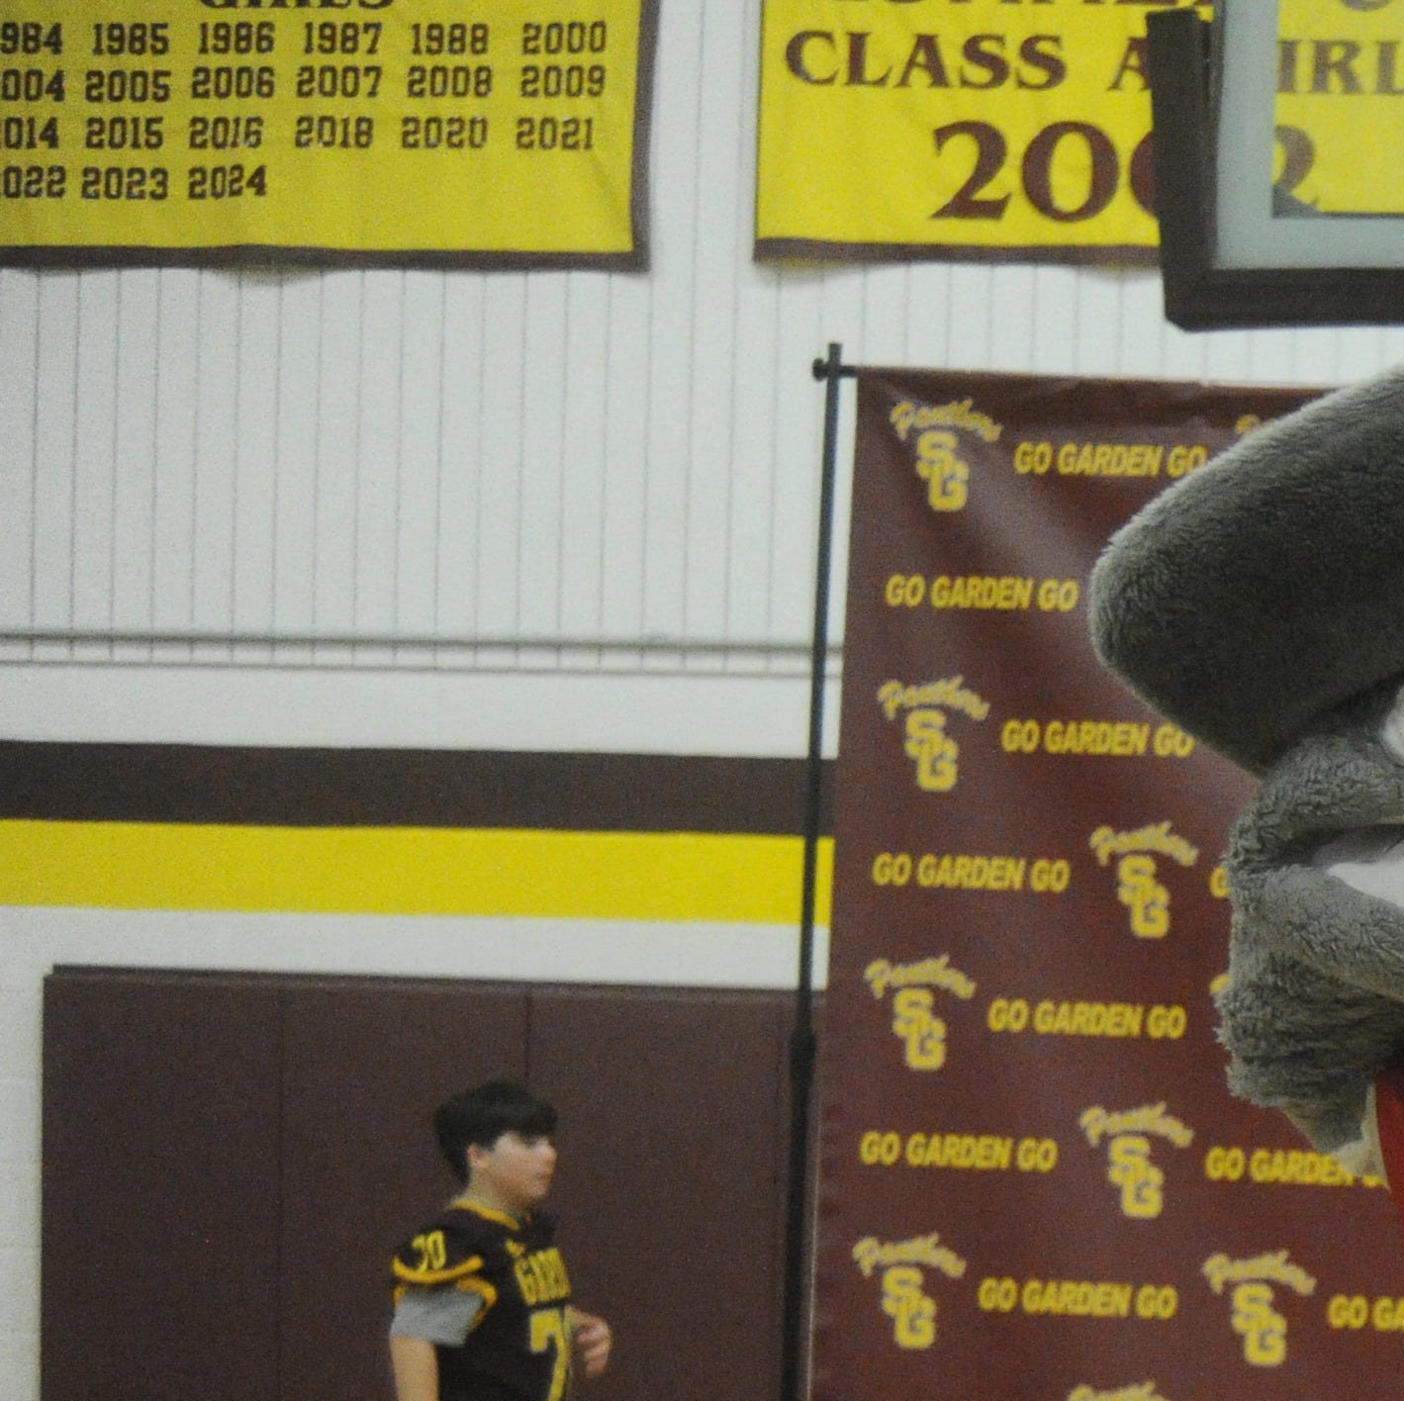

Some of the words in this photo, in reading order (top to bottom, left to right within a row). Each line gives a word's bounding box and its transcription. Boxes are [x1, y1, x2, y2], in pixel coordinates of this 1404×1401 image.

[0, 21, 63, 55] 984
[92, 22, 170, 56] 1985
[198, 21, 276, 55] 1986
[304, 21, 383, 55] 1987
[411, 22, 490, 56] 1988
[522, 20, 608, 55] 2000
[785, 29, 1068, 92] CLASS
[0, 68, 66, 102] 004
[84, 69, 172, 103] 2005
[191, 66, 276, 99] 2006
[296, 65, 383, 98] 2007
[406, 65, 493, 98] 2008
[520, 65, 607, 98] 2009
[2, 116, 60, 150] 014
[85, 116, 165, 150] 2015
[188, 116, 265, 150] 2016
[295, 115, 375, 149] 2018
[401, 116, 489, 149] 2020
[515, 117, 594, 150] 2021
[2, 165, 67, 199] 022
[81, 167, 170, 201] 2023
[188, 164, 268, 200] 2024
[1013, 441, 1052, 475] GO
[1056, 442, 1163, 477] GARDEN
[885, 573, 927, 609] GO
[929, 574, 1035, 612] GARDEN
[1036, 578, 1081, 613] GO
[1002, 718, 1042, 755] GO
[1045, 720, 1151, 758] GARDEN
[872, 852, 914, 888] GO
[916, 853, 1027, 892] GARDEN
[1028, 858, 1072, 895] GO
[988, 997, 1029, 1034] GO
[1032, 999, 1144, 1039] GARDEN
[1145, 1003, 1189, 1040] GO
[860, 1130, 902, 1168] GO
[905, 1131, 1014, 1172] GARDEN
[1015, 1135, 1060, 1174] GO
[1204, 1145, 1247, 1183] GO
[1249, 1148, 1356, 1188] GARDE
[977, 1276, 1019, 1313] GO
[1021, 1279, 1133, 1319] GARDEN
[1135, 1283, 1180, 1321] GO
[1327, 1293, 1369, 1330] GO
